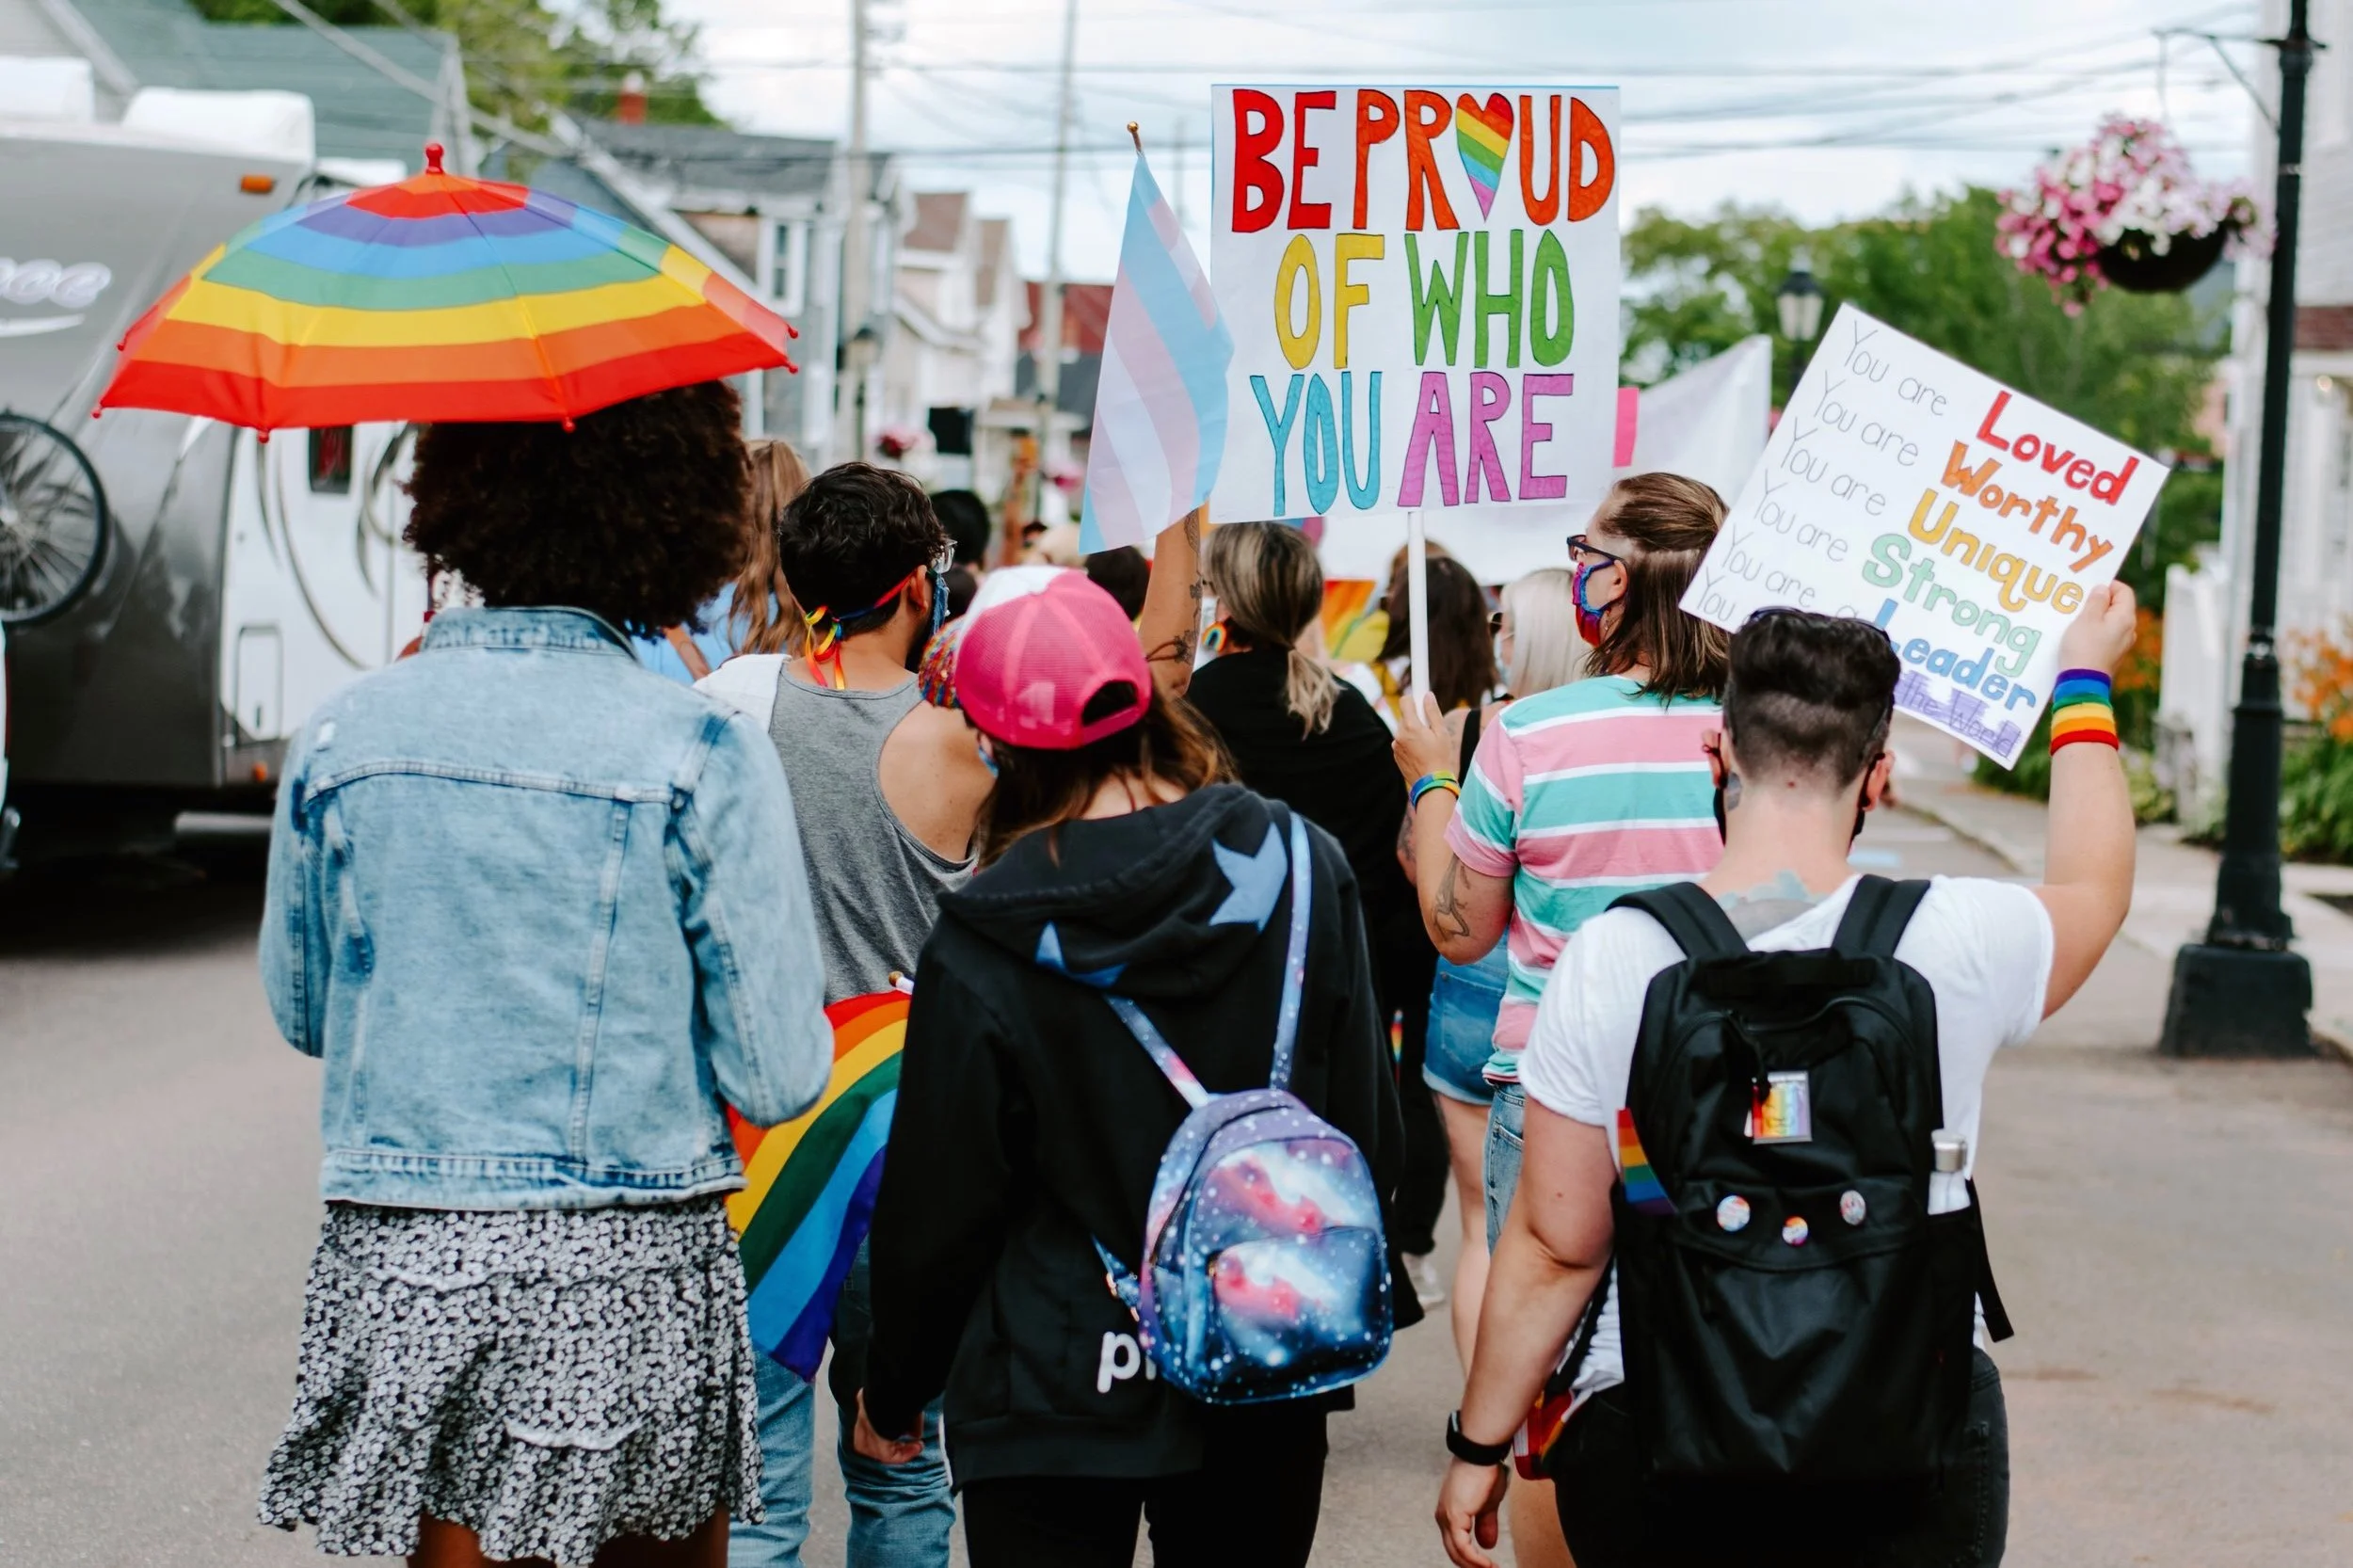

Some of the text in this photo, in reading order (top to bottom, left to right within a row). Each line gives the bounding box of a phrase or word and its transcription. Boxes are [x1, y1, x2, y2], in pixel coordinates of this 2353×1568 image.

[1232, 89, 1337, 232] BE
[1274, 229, 1574, 370] OF WHO
[1250, 371, 1574, 517] YOU ARE
[1814, 370, 2114, 573] You are Worthy
[1844, 320, 2139, 505] You are Loved
[1721, 522, 1763, 582] You
[1765, 570, 1817, 608] are
[1753, 469, 2042, 678] You are Strong
[1781, 417, 2084, 614] You are Unique
[1697, 566, 1736, 621] You
